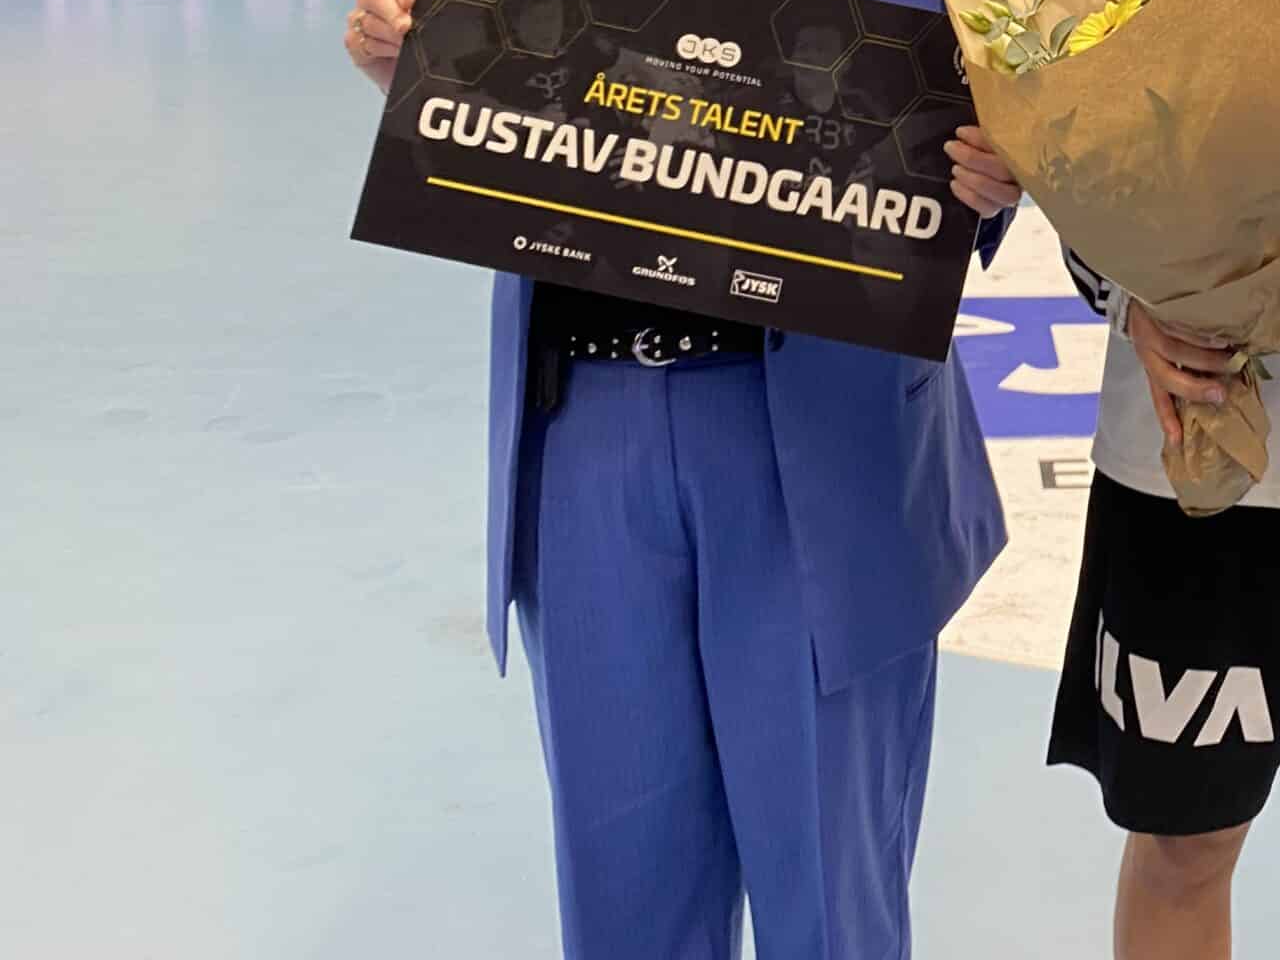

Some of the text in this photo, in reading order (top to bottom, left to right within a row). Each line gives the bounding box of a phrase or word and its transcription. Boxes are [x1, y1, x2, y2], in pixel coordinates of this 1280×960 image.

[684, 63, 711, 78] YOUR
[712, 69, 763, 87] POTENTIAL
[584, 72, 804, 145] ÅRETS TALENT
[418, 96, 943, 240] GUSTAV BUNDGAARD
[529, 240, 592, 262] JYSKE BANK
[632, 265, 696, 287] GRUNDFOS
[740, 277, 779, 297] JYSK
